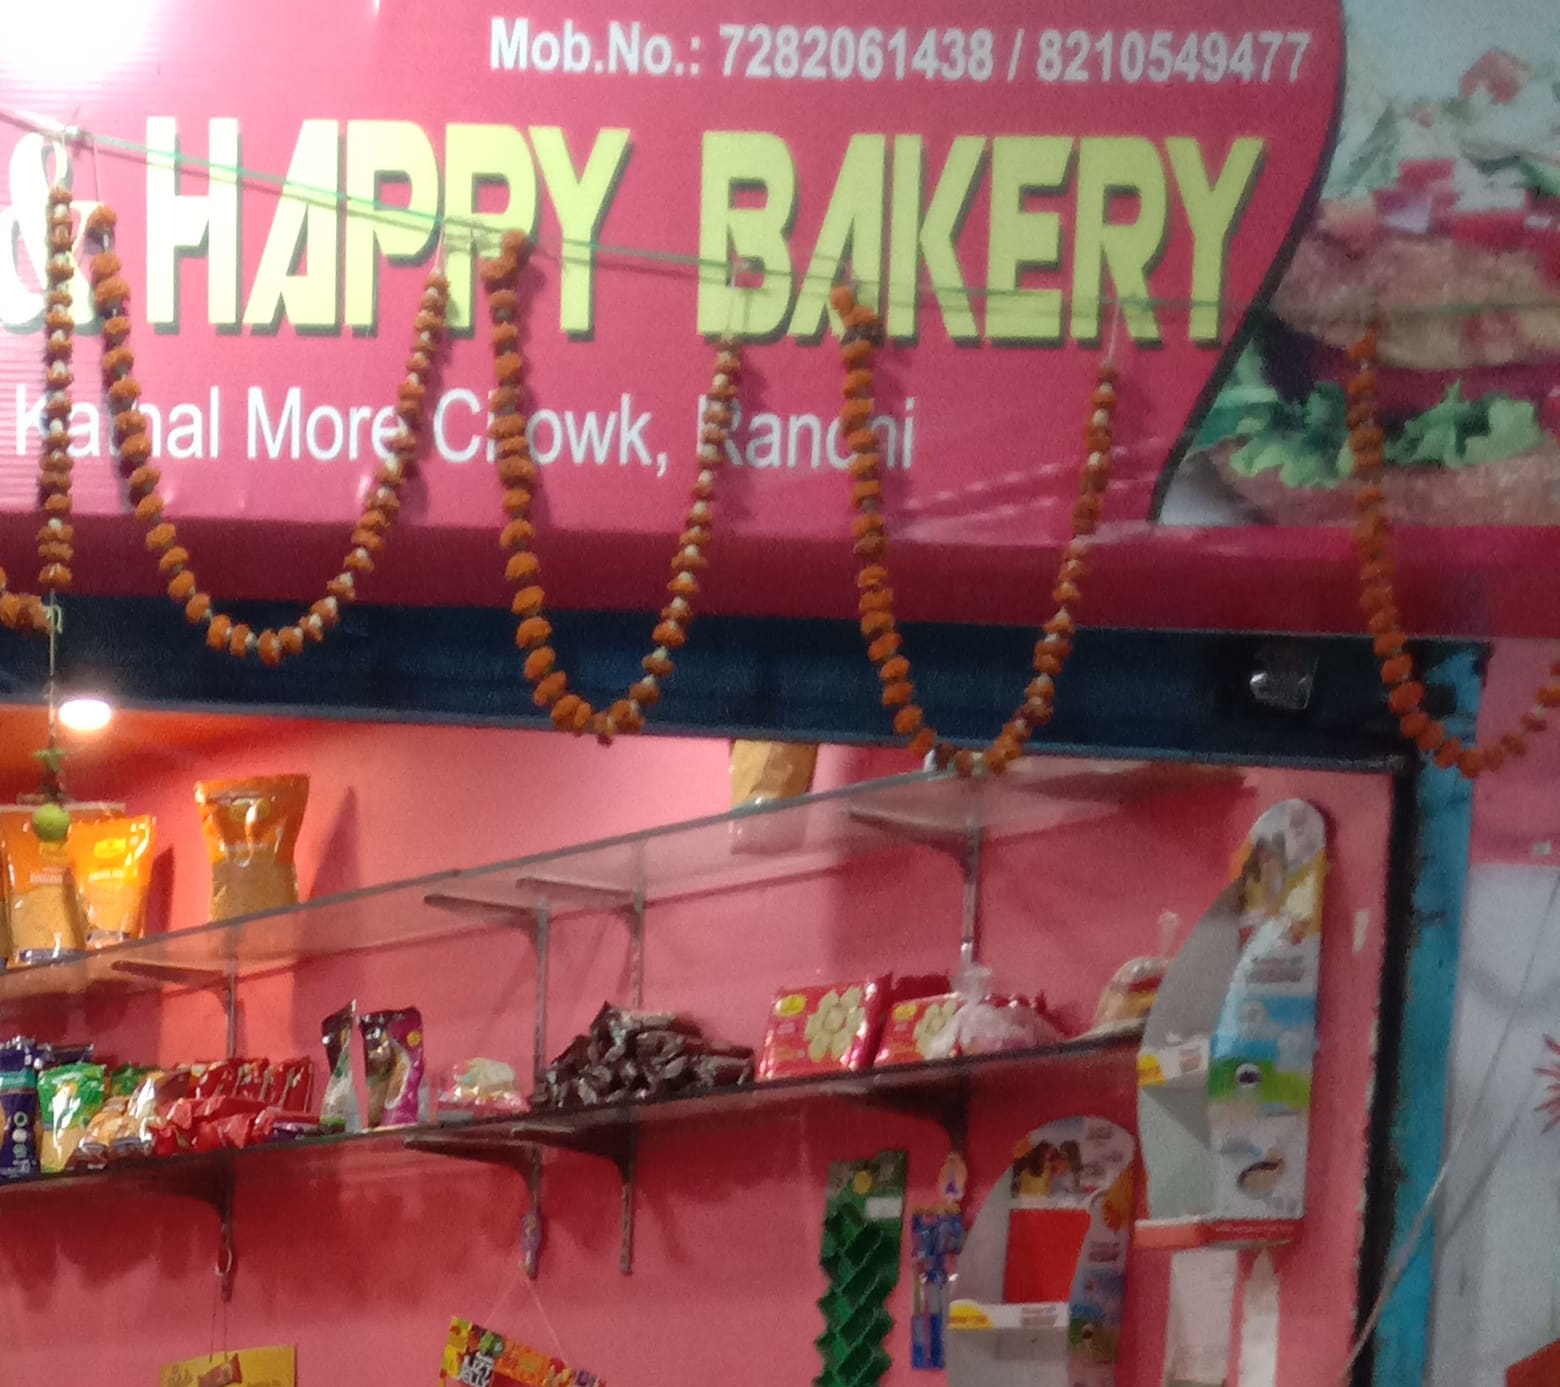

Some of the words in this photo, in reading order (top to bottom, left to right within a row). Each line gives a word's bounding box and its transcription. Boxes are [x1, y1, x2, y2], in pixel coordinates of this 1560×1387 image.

[490, 17, 701, 78] Mob.No.:
[717, 25, 994, 82] 7282061438
[1007, 30, 1022, 82] /
[1036, 28, 1311, 85] 8210549477
[146, 117, 630, 333] HAPPY
[696, 130, 1264, 341] BAKERY
[247, 387, 406, 460] More
[434, 388, 668, 477] Cowk,
